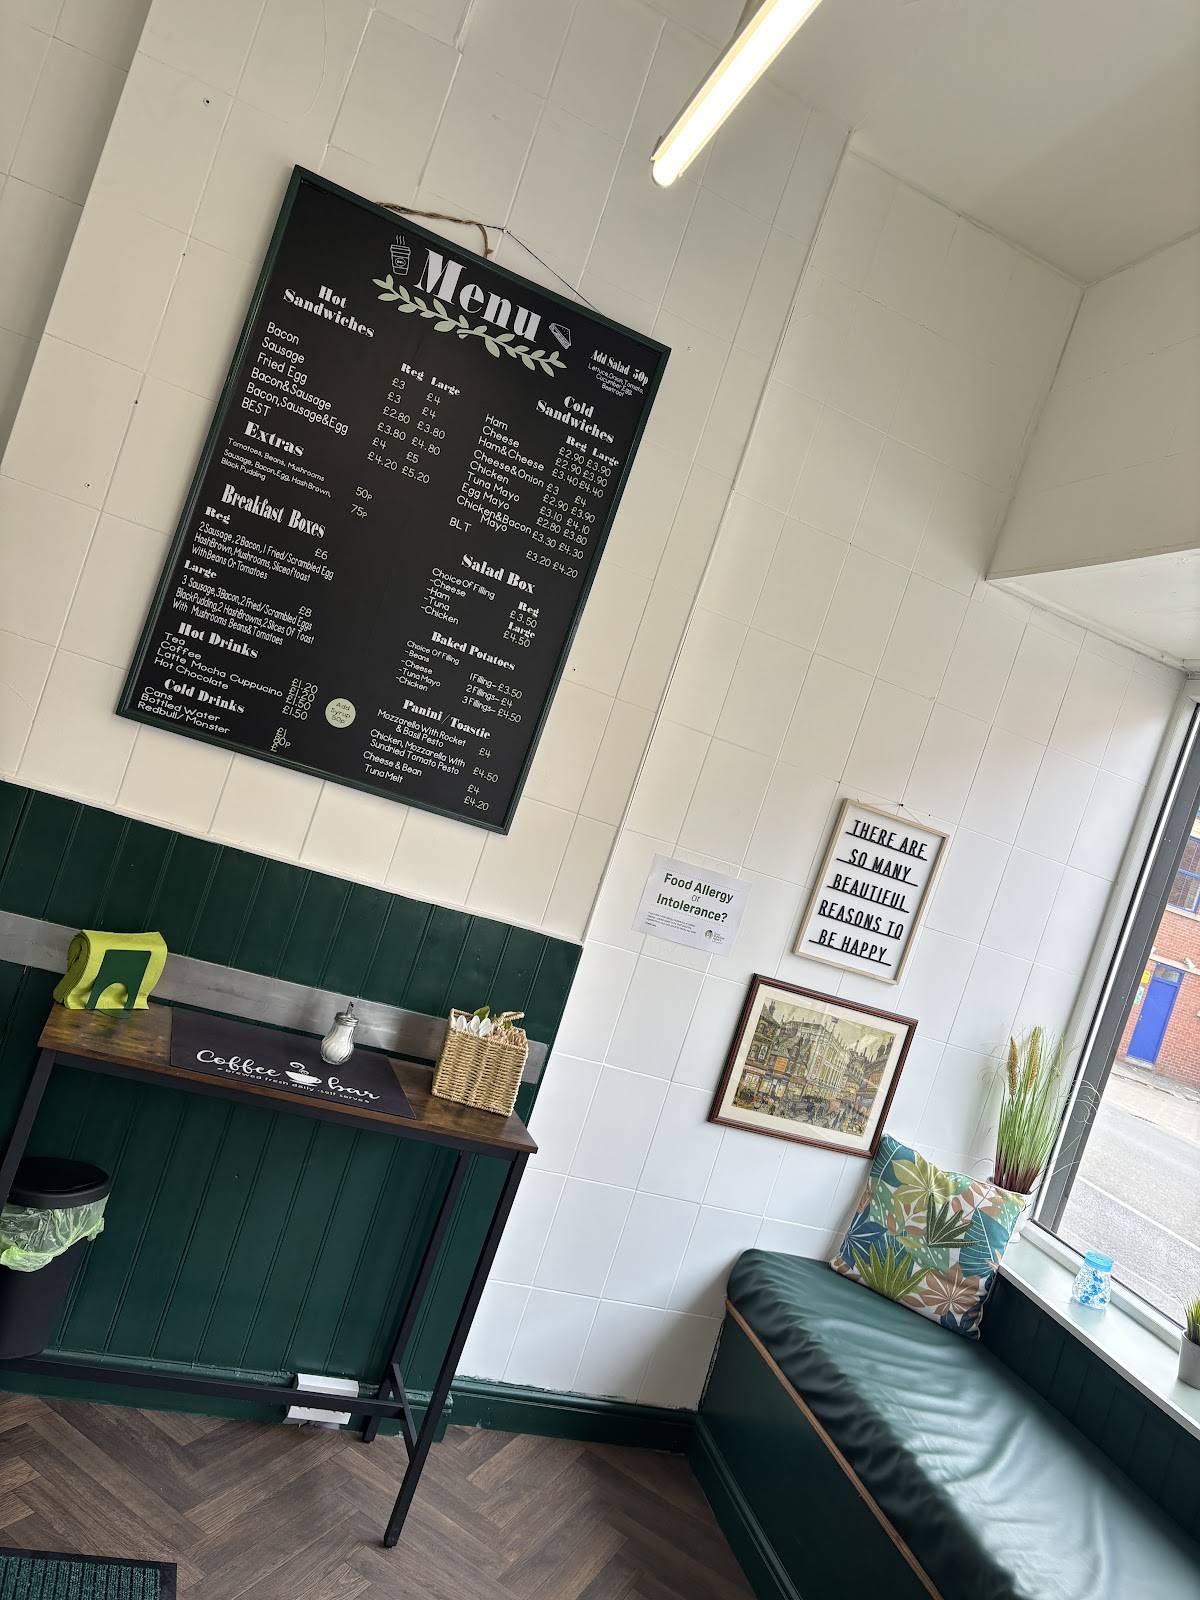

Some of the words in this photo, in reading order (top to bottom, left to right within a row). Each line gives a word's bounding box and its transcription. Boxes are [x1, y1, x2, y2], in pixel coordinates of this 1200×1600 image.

[283, 289, 374, 337] Sandwiches
[318, 285, 346, 308] Hot
[413, 248, 541, 343] Menu
[262, 337, 305, 364] Sausage
[387, 392, 401, 404] £3
[422, 407, 436, 419] £4
[267, 322, 299, 345] Bacon
[392, 378, 405, 390] £3
[426, 393, 440, 406] £4
[401, 363, 424, 381] Reg
[431, 377, 460, 395] Large
[591, 350, 607, 364] Add
[607, 357, 630, 375] Salad
[633, 369, 648, 386] 50p
[251, 367, 331, 410] Bacon&Sausage
[377, 422, 406, 441] £3.80
[411, 437, 440, 455] £4.80
[257, 352, 286, 373] Fried
[287, 365, 307, 385] Egg
[383, 406, 410, 424] £2.80
[417, 421, 445, 439] £3.80
[564, 396, 594, 418] Cold
[244, 421, 304, 456] Extras
[536, 400, 614, 443] Sandwiches
[242, 397, 271, 416] BEST
[367, 452, 397, 470] £4.20
[401, 466, 430, 483] £5.20
[372, 437, 386, 450] £4
[406, 452, 419, 463] £5
[483, 426, 519, 448] Cheese
[555, 458, 581, 475] £2.90
[583, 470, 607, 487] £3.90
[485, 414, 508, 431] Ham
[558, 447, 584, 464] £2.90
[586, 459, 611, 477] £3.90
[566, 436, 587, 453] Reg
[592, 448, 619, 466] Large
[288, 462, 324, 482] Mushrooms
[356, 487, 372, 501] 50p
[474, 450, 544, 488] Cheese&Onion
[546, 483, 559, 495] £3
[574, 496, 586, 507] £4
[478, 436, 544, 471] Ham&Cheese
[552, 469, 578, 486] £3.40
[579, 481, 603, 498] £4.40
[221, 457, 239, 470] Black
[240, 465, 266, 481] Pudding
[351, 504, 367, 518] 75p
[468, 471, 491, 489] Tuna
[493, 483, 520, 502] Mayo
[539, 507, 562, 522] £3.10
[566, 518, 590, 535] £4.10
[470, 461, 509, 484] Chicken
[543, 494, 568, 511] £2.90
[571, 507, 595, 523] £3.90
[221, 484, 284, 523] Breakfast
[288, 509, 326, 538] Boxes
[457, 495, 531, 534] Chicken&Bacon
[532, 531, 556, 548] £3.30
[558, 543, 583, 559] £4.30
[462, 482, 481, 500] Egg
[483, 492, 509, 510] Mayo
[536, 517, 561, 533] £2.80
[563, 529, 587, 545] £3.80
[480, 514, 507, 532] Mayo
[205, 507, 230, 524] Reg
[315, 548, 328, 560] £6
[321, 566, 334, 581] Egg
[432, 568, 462, 585] Choice
[462, 554, 504, 581] Salad
[507, 572, 535, 594] Box
[526, 550, 551, 567] £3.20
[552, 562, 578, 578] £4.20
[184, 560, 217, 578] Large
[298, 606, 312, 617] £8
[173, 598, 188, 612] With
[191, 605, 227, 626] Mushrooms
[518, 601, 539, 618] Reg
[178, 622, 205, 641] Hot
[208, 632, 258, 658] Drinks
[297, 630, 314, 644] Toast
[407, 640, 430, 654] Choice
[503, 631, 530, 648] £4.50
[508, 622, 535, 638] Large
[161, 641, 201, 660] Coffee
[165, 632, 185, 645] Tea
[291, 678, 318, 694] £1.20
[431, 631, 467, 652] Baked
[469, 645, 515, 670] Potatoes
[154, 657, 174, 669] Hot
[176, 665, 228, 690] Chocolate
[282, 705, 308, 720] £1.50
[157, 648, 186, 664] Latte
[191, 660, 226, 678] Mocha
[230, 674, 283, 697] Cuppucino
[421, 675, 441, 687] Mayo
[141, 693, 182, 712] Bottled
[184, 707, 220, 721] Water
[145, 687, 173, 700] Cans
[164, 679, 195, 697] Cold
[197, 690, 245, 713] Drinks
[497, 684, 522, 699] £3.50
[501, 698, 512, 708] £4
[138, 701, 183, 719] Redbull/
[186, 715, 230, 733] Monster
[378, 709, 420, 730] Mozzarella
[421, 724, 439, 737] With
[439, 731, 466, 747] Rocket
[403, 700, 443, 721] Panini
[451, 717, 490, 739] Toastie
[497, 708, 521, 723] £4.50
[396, 725, 402, 733] &
[421, 733, 444, 747] Pesto
[479, 748, 491, 758] £4
[363, 751, 394, 767] Cheese
[395, 761, 400, 770] &
[402, 763, 422, 776] Bean
[370, 739, 406, 757] Sundried
[407, 750, 436, 767] Tomato
[437, 761, 459, 775] Pesto
[371, 729, 403, 748] Chicken,
[405, 741, 447, 761] Mozzarella
[449, 755, 465, 767] With
[473, 767, 498, 782] £4.50
[365, 764, 385, 777] Tuna
[385, 771, 403, 783] Melt
[467, 784, 480, 795] £4
[464, 796, 489, 811] £4.20
[851, 819, 898, 848] THERE
[900, 837, 928, 860] ARE
[848, 849, 868, 867] SO
[872, 856, 912, 882] MANY
[664, 873, 693, 890] Food
[693, 882, 734, 904] Allergy
[832, 873, 907, 912] BEAUTIFUL
[656, 893, 728, 923] Intolerance?
[818, 899, 883, 933] REASONS
[887, 921, 904, 939] TO
[818, 929, 838, 948] BE
[841, 935, 888, 963] HAPPY
[196, 1049, 281, 1077] Coffee
[327, 1076, 381, 1100] bar
[225, 1069, 262, 1080] brewed
[265, 1077, 289, 1085] fresh
